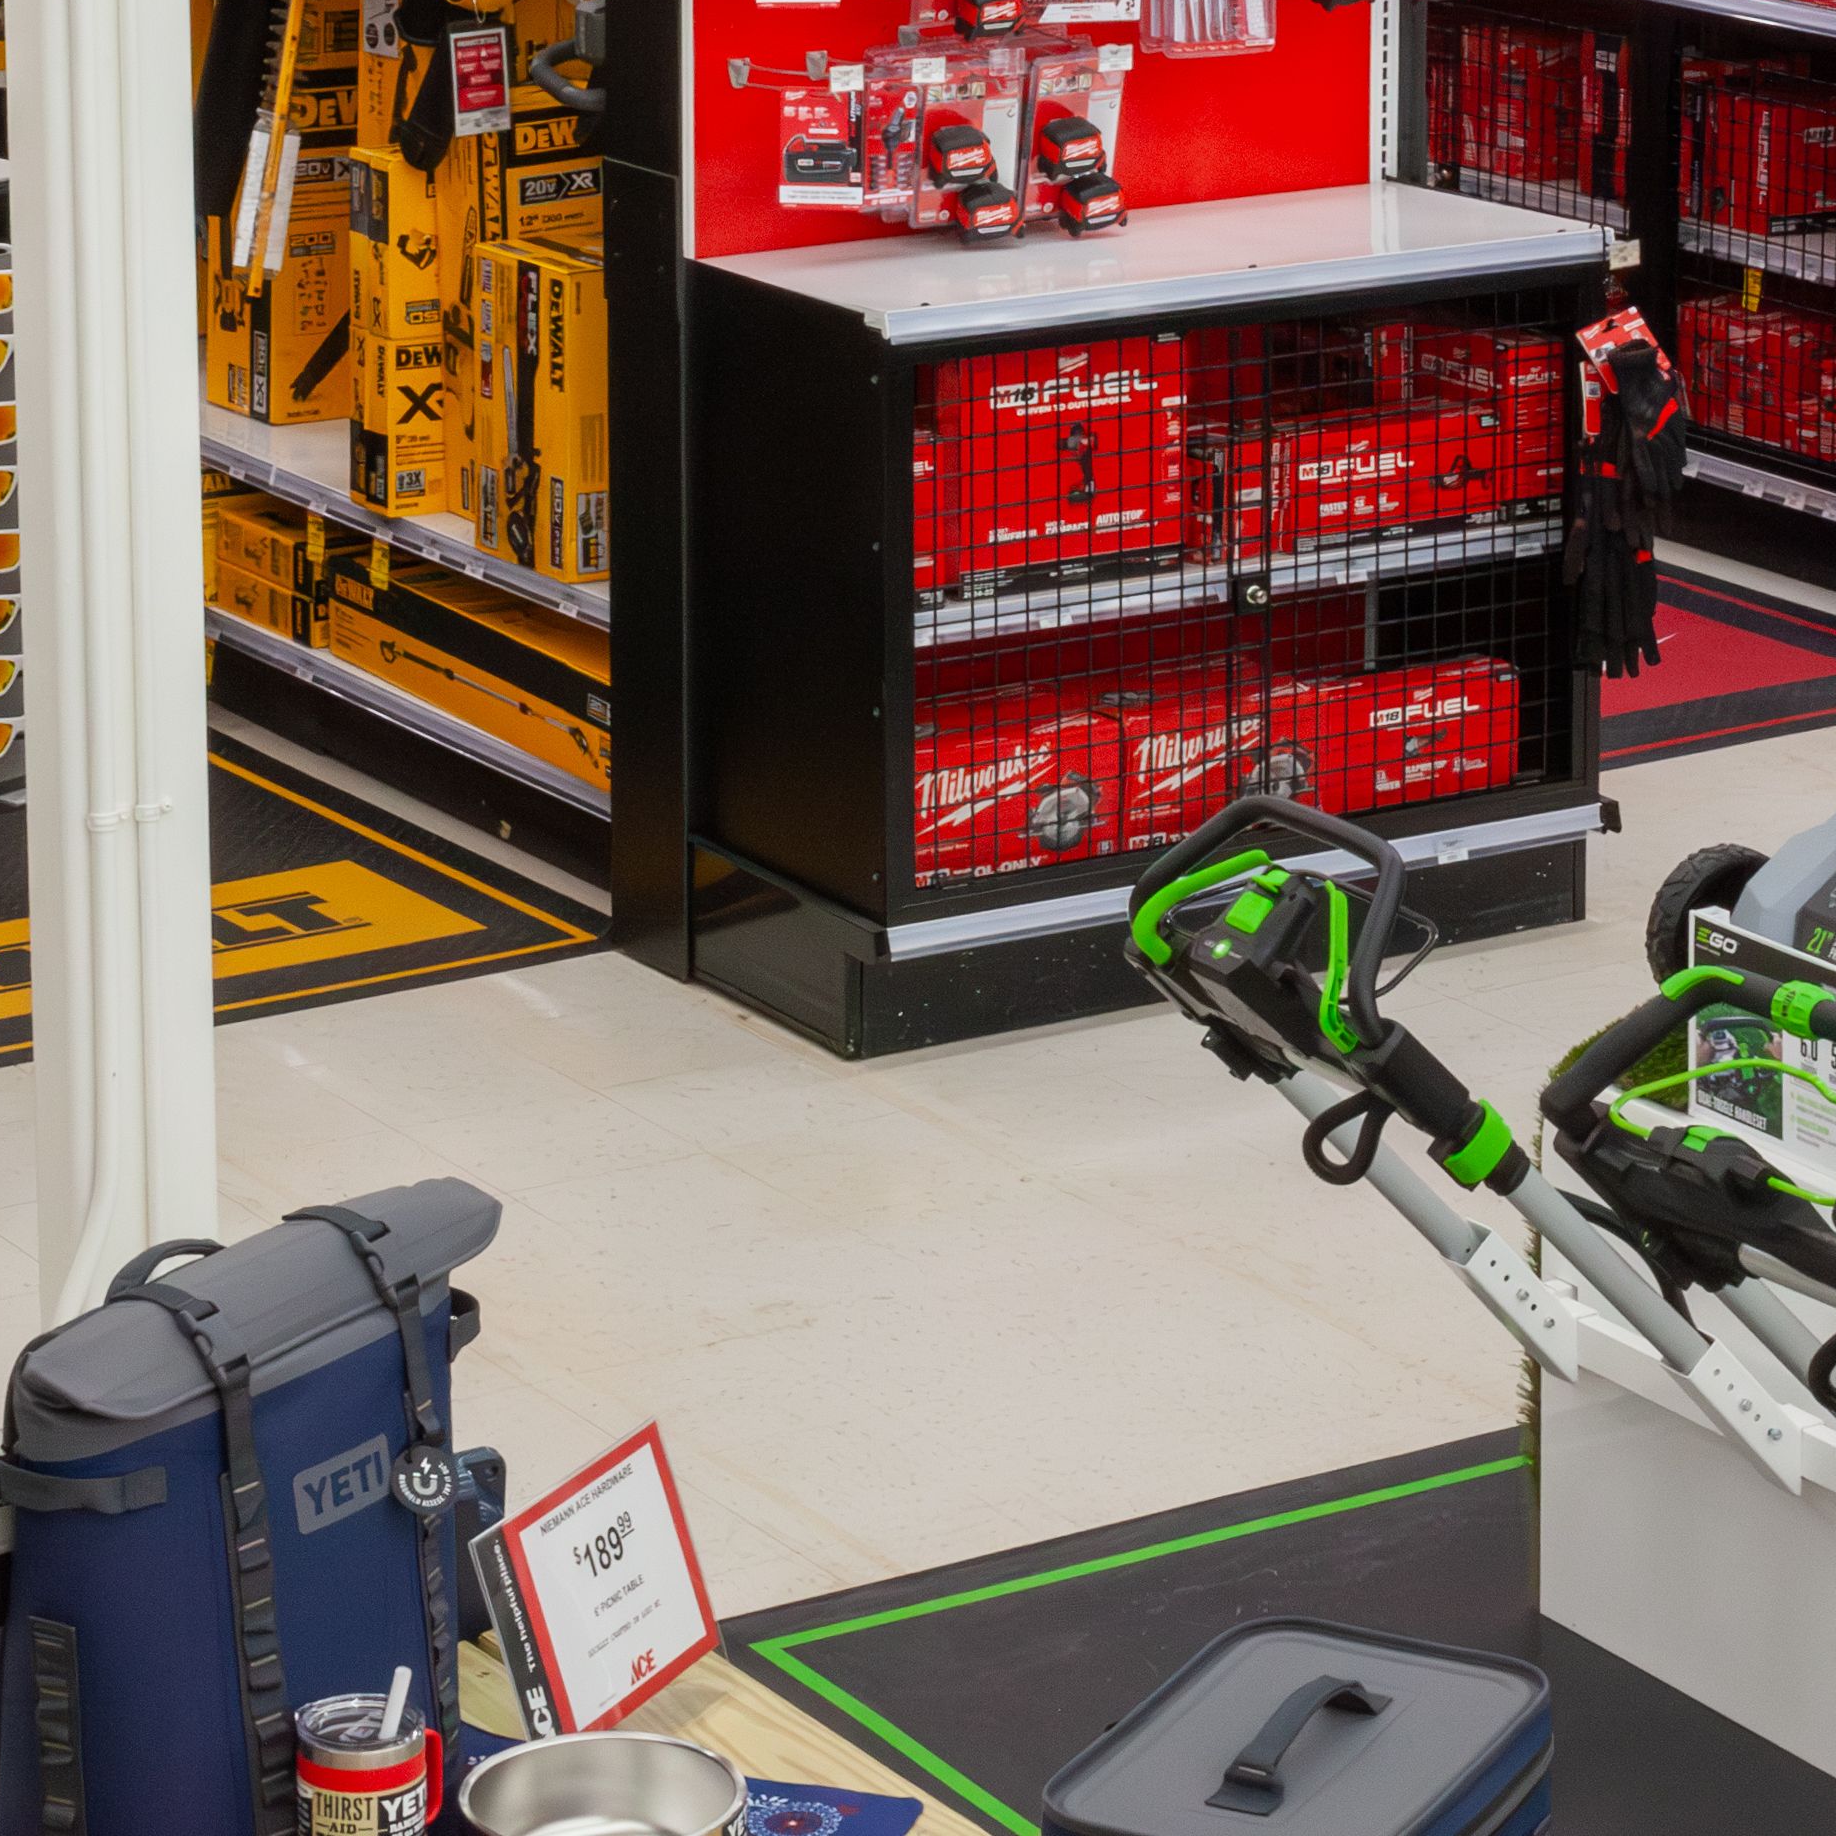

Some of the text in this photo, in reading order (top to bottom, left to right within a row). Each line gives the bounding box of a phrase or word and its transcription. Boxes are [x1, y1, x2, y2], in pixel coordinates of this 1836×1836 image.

[1043, 370, 1158, 402] FUEL
[1336, 452, 1414, 476] FUEL
[1405, 695, 1480, 718] FUEL
[916, 742, 1050, 806] Milwaukee
[301, 1449, 384, 1517] YETI
[540, 1464, 634, 1536] NIEMANN ACE HARDWARE
[494, 1538, 536, 1674] The helpful place.
[630, 1648, 657, 1685] ACE
[316, 1795, 373, 1821] THIRST
[329, 1823, 356, 1833] AID
